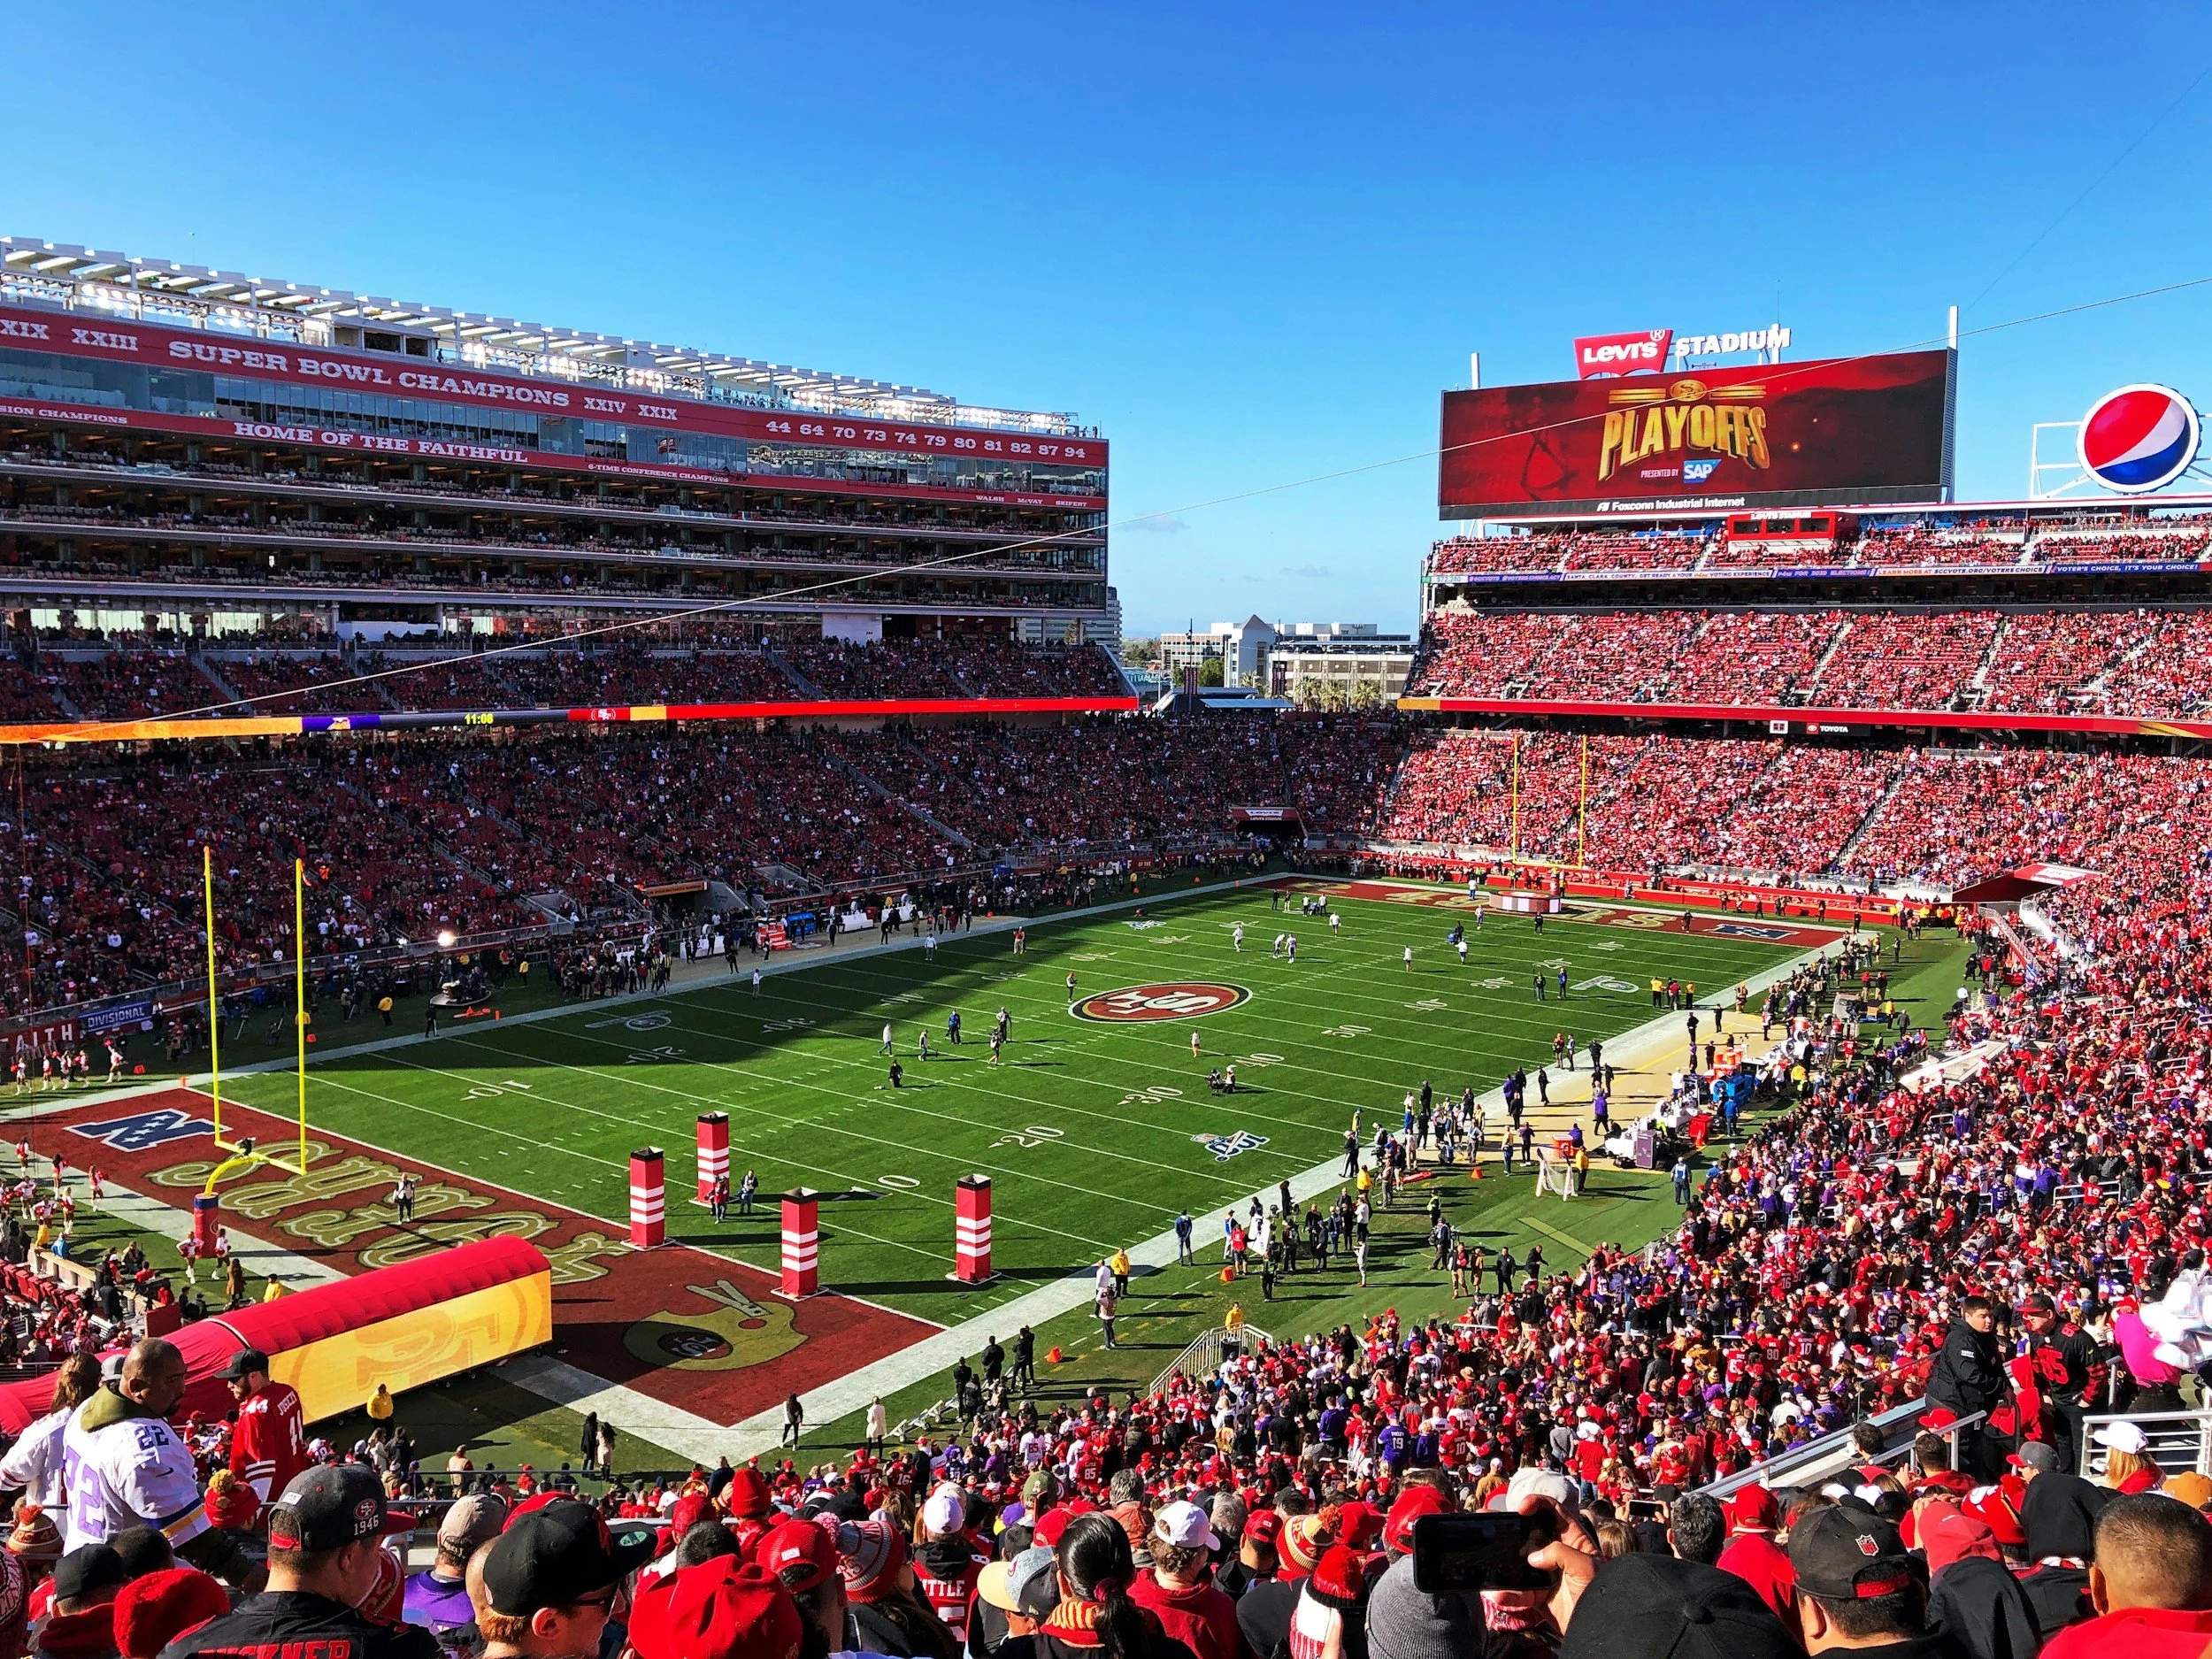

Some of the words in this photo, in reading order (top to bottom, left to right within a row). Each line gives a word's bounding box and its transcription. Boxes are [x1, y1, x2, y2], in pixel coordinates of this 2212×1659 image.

[71, 328, 138, 351] XXIII
[1674, 327, 1791, 357] STADIUM
[169, 341, 288, 373] SUPER
[297, 357, 391, 386] BOWL
[399, 372, 570, 407] CHAMPIONS
[38, 409, 127, 425] CHAMPIONS
[583, 396, 626, 413] XXIV
[638, 403, 678, 421] XXIX
[234, 422, 313, 442] HOME
[320, 432, 353, 446] OF
[359, 434, 409, 451] THE
[418, 441, 528, 463] FAITHFUL
[765, 420, 792, 434] 44
[799, 424, 825, 436] 64
[833, 426, 856, 439] 70
[864, 429, 887, 442] 73
[895, 432, 917, 444] 74
[924, 434, 947, 447] 79
[953, 437, 977, 449] 80
[984, 440, 1002, 451] 81
[1010, 442, 1032, 454] 82
[1038, 444, 1059, 457] 87
[1064, 447, 1086, 458] 94
[1598, 403, 1770, 482] PLAYOFFS
[621, 466, 678, 479] CONFERENCE
[679, 472, 729, 483] CHAMPIONS
[1640, 469, 1671, 479] PRESENTED
[1671, 468, 1679, 477] BY
[1684, 463, 1713, 480] SAP
[1611, 501, 1655, 511] Foxconn
[1655, 498, 1704, 510] Industrial
[1705, 496, 1746, 507] Internet
[465, 712, 494, 725] 11:08
[88, 1007, 145, 1027] DIVISIONAL
[1235, 1052, 1286, 1068] 40
[1122, 1086, 1184, 1105] 30
[1000, 1125, 1065, 1149] 20
[134, 1425, 170, 1451] 22
[1392, 1437, 1404, 1450] 19
[1084, 1467, 1096, 1479] 85
[354, 1515, 380, 1536] 1946
